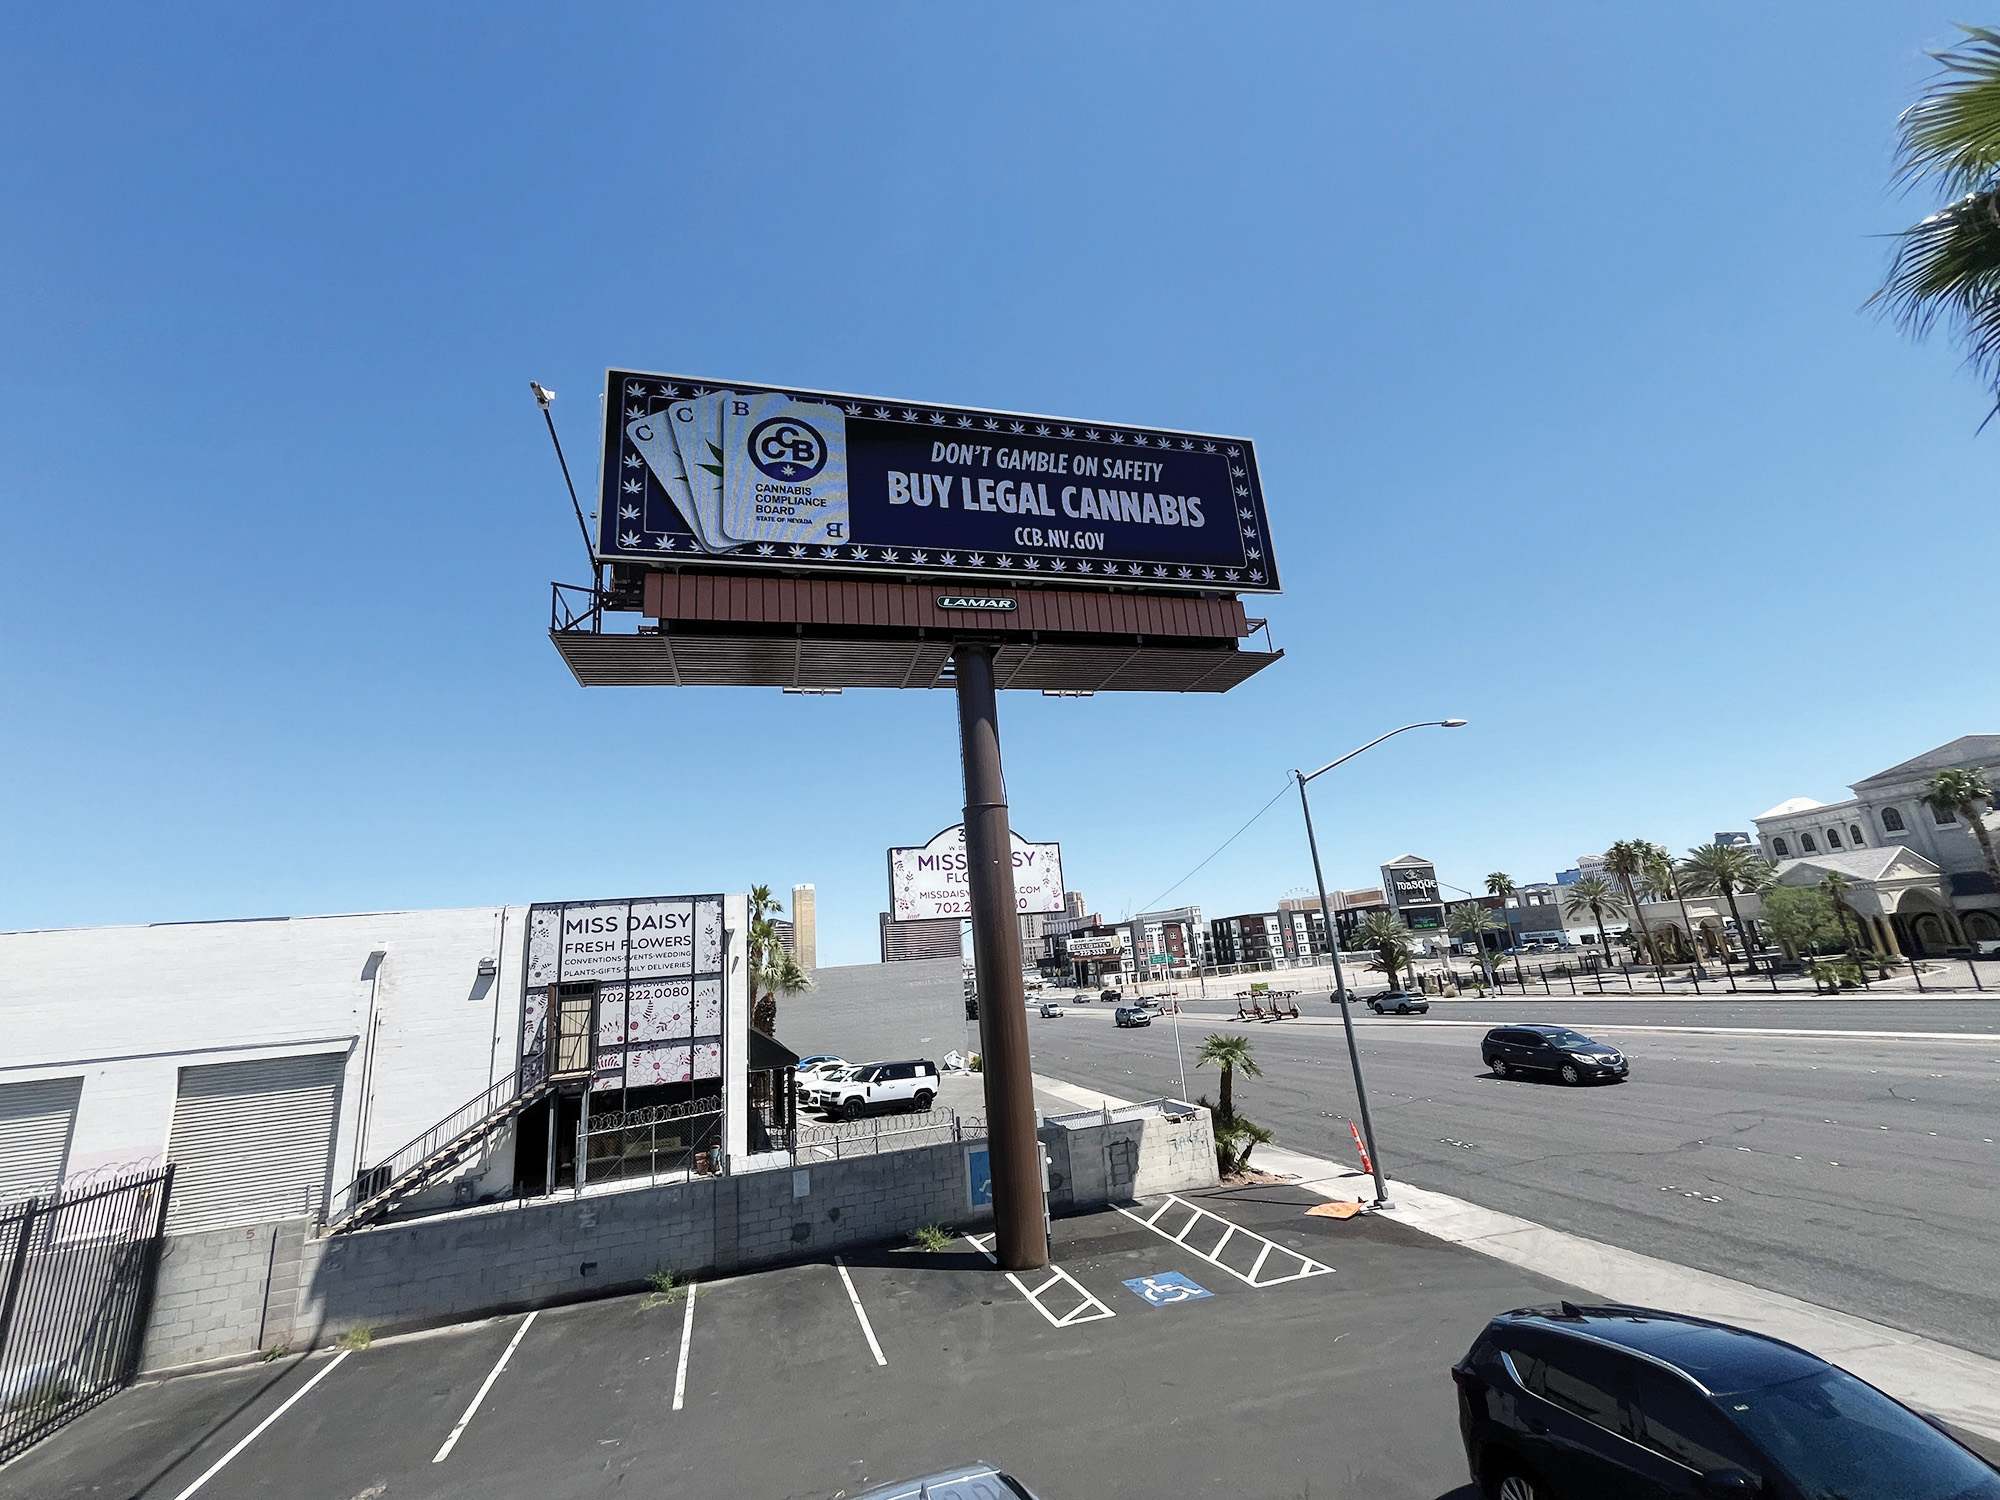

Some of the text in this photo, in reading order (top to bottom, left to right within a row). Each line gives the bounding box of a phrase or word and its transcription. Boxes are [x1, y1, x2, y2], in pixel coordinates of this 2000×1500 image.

[676, 407, 694, 422] C
[732, 401, 750, 416] B
[635, 424, 654, 441] C
[931, 441, 1163, 482] DON'T GAMBLE ON SAFETY
[755, 483, 812, 496] CANNABIS
[755, 494, 827, 508] COMPLIANCE
[888, 470, 1206, 527] BUY LEGAL CANNABIS
[755, 504, 795, 516] BOARD
[756, 515, 776, 523] STATE
[786, 517, 813, 525] NEVADA
[1014, 526, 1105, 551] CCB.NV.GOV
[942, 598, 1012, 608] LAMAR
[917, 854, 968, 871] MISS
[566, 913, 692, 935] MISS DAISY
[565, 935, 692, 954] FRESH FLOWERS
[1070, 942, 1111, 951] GOLIGHTLY
[647, 961, 692, 971] DELIVERIES
[600, 986, 690, 1004] 702222.0080
